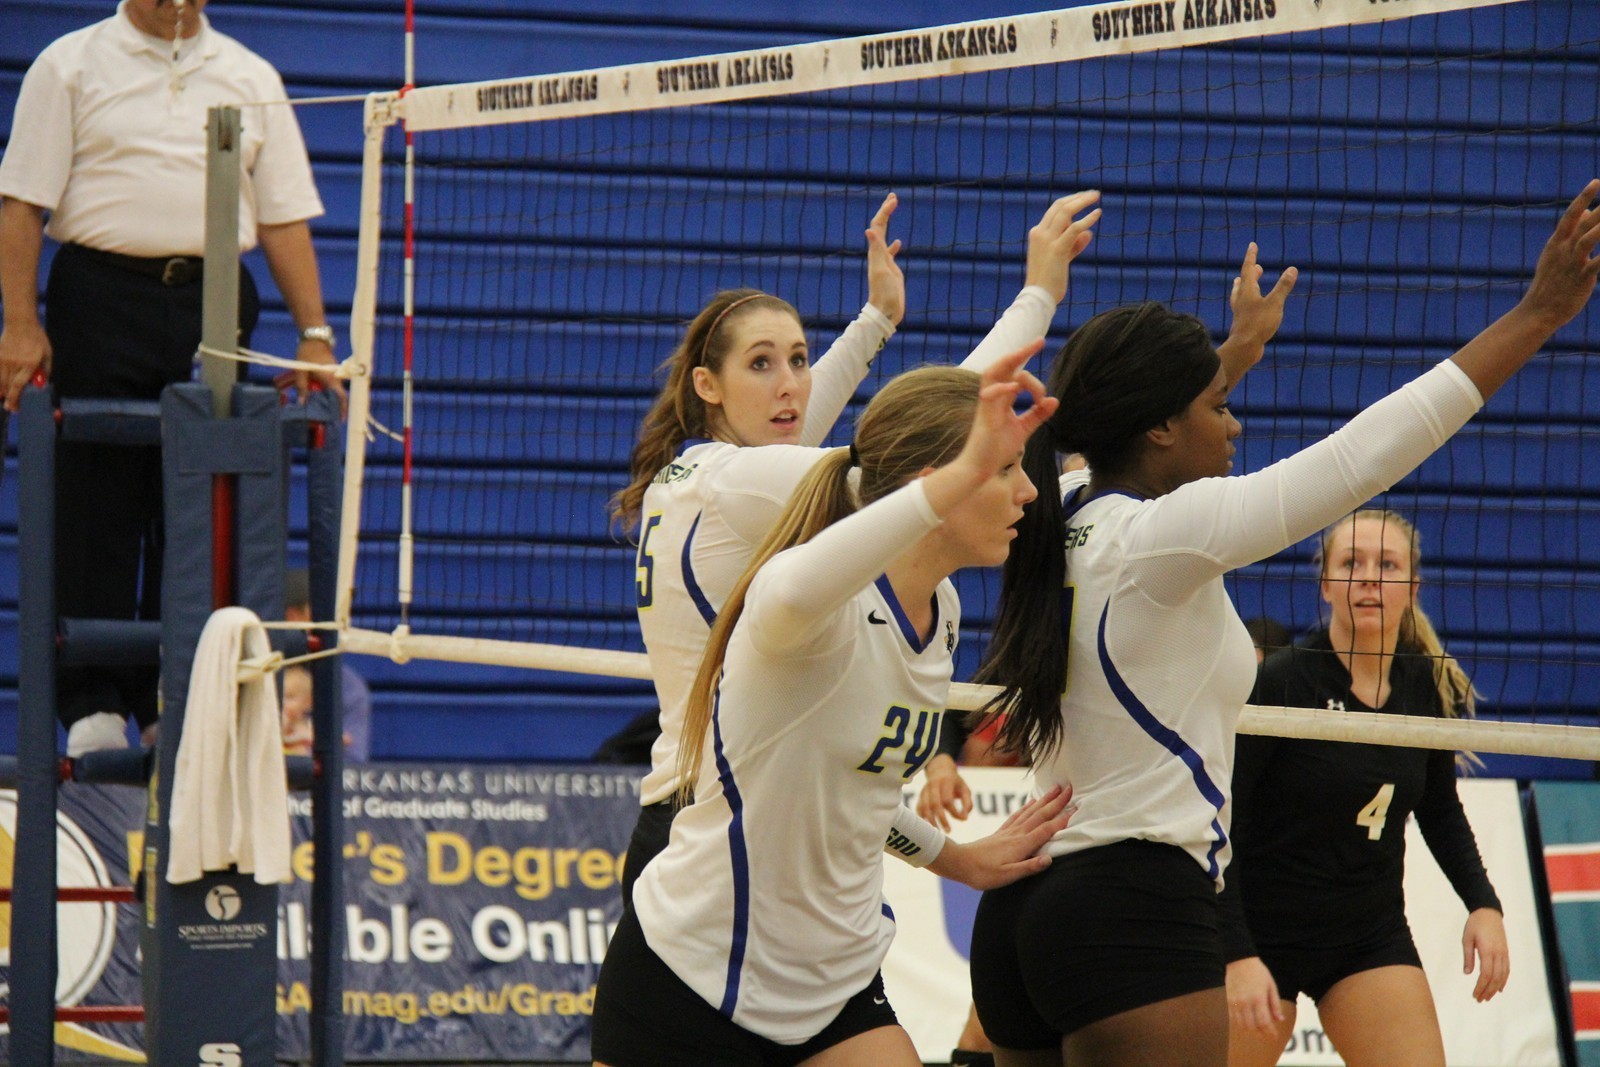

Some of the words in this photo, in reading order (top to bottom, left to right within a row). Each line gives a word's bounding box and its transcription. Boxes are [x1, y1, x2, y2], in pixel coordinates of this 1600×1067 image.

[1091, 1, 1176, 42] SOUTHERN
[1182, 0, 1277, 30] ARKANSAS
[860, 34, 933, 71] SOUTHERN
[936, 22, 1018, 62] ARKANSAS
[656, 61, 721, 94] SOUTHERN
[725, 51, 794, 87] ARKANSAS
[856, 705, 941, 779] 24
[342, 768, 474, 795] RKANSAS
[485, 771, 642, 798] UNIVERSITY
[364, 796, 462, 820] Graduate
[471, 797, 549, 822] Studies
[1356, 783, 1395, 841] 4
[426, 831, 626, 900] Degre
[471, 903, 618, 965] Onli
